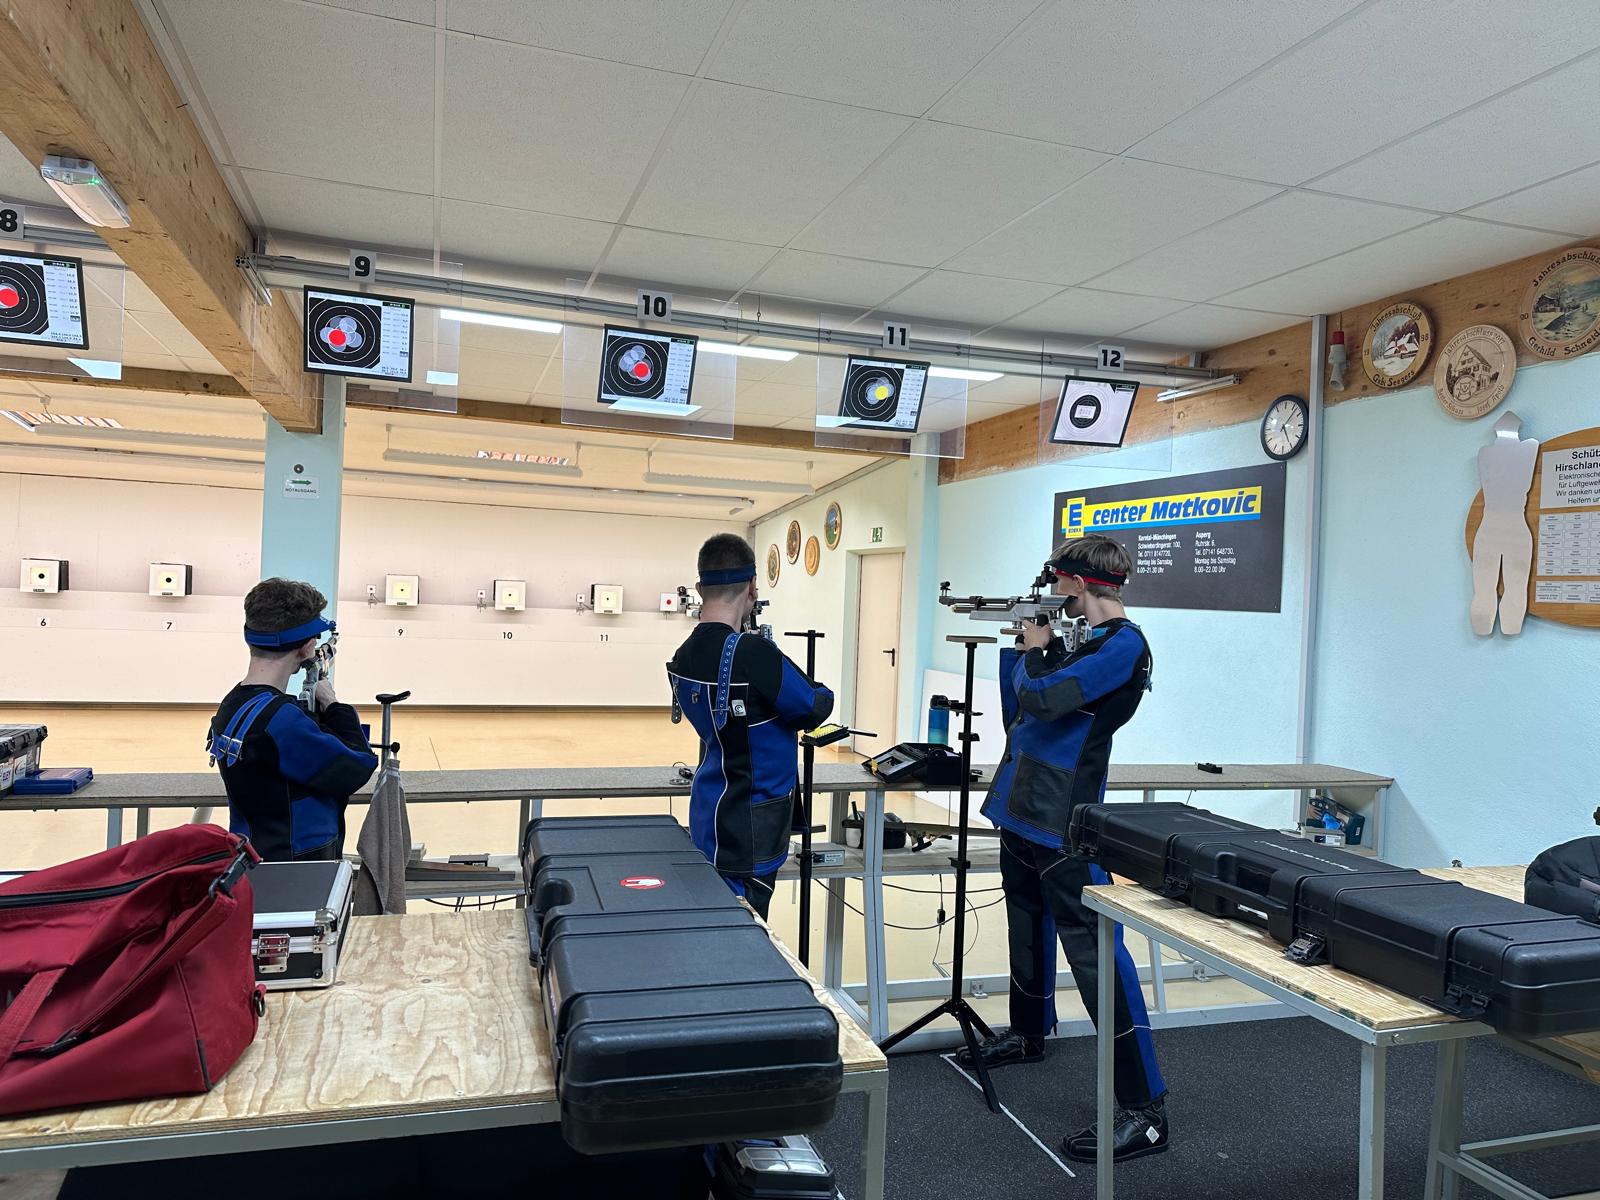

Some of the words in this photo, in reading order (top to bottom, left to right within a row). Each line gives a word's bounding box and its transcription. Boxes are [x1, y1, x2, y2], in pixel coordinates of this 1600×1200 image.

[0, 209, 18, 232] 8
[355, 255, 371, 277] 9
[642, 294, 667, 318] 10
[887, 326, 907, 346] 11
[1563, 327, 1600, 355] Schneid
[1101, 349, 1121, 368] 12
[1571, 448, 1600, 459] Schüt
[1568, 488, 1592, 496] danken
[1092, 504, 1147, 526] center
[1150, 491, 1258, 521] Matkovic
[1195, 531, 1211, 540] Asperg
[40, 618, 47, 627] 6
[166, 621, 173, 630] 7
[398, 628, 404, 637] 9
[502, 631, 513, 640] 10
[600, 634, 609, 642] 11
